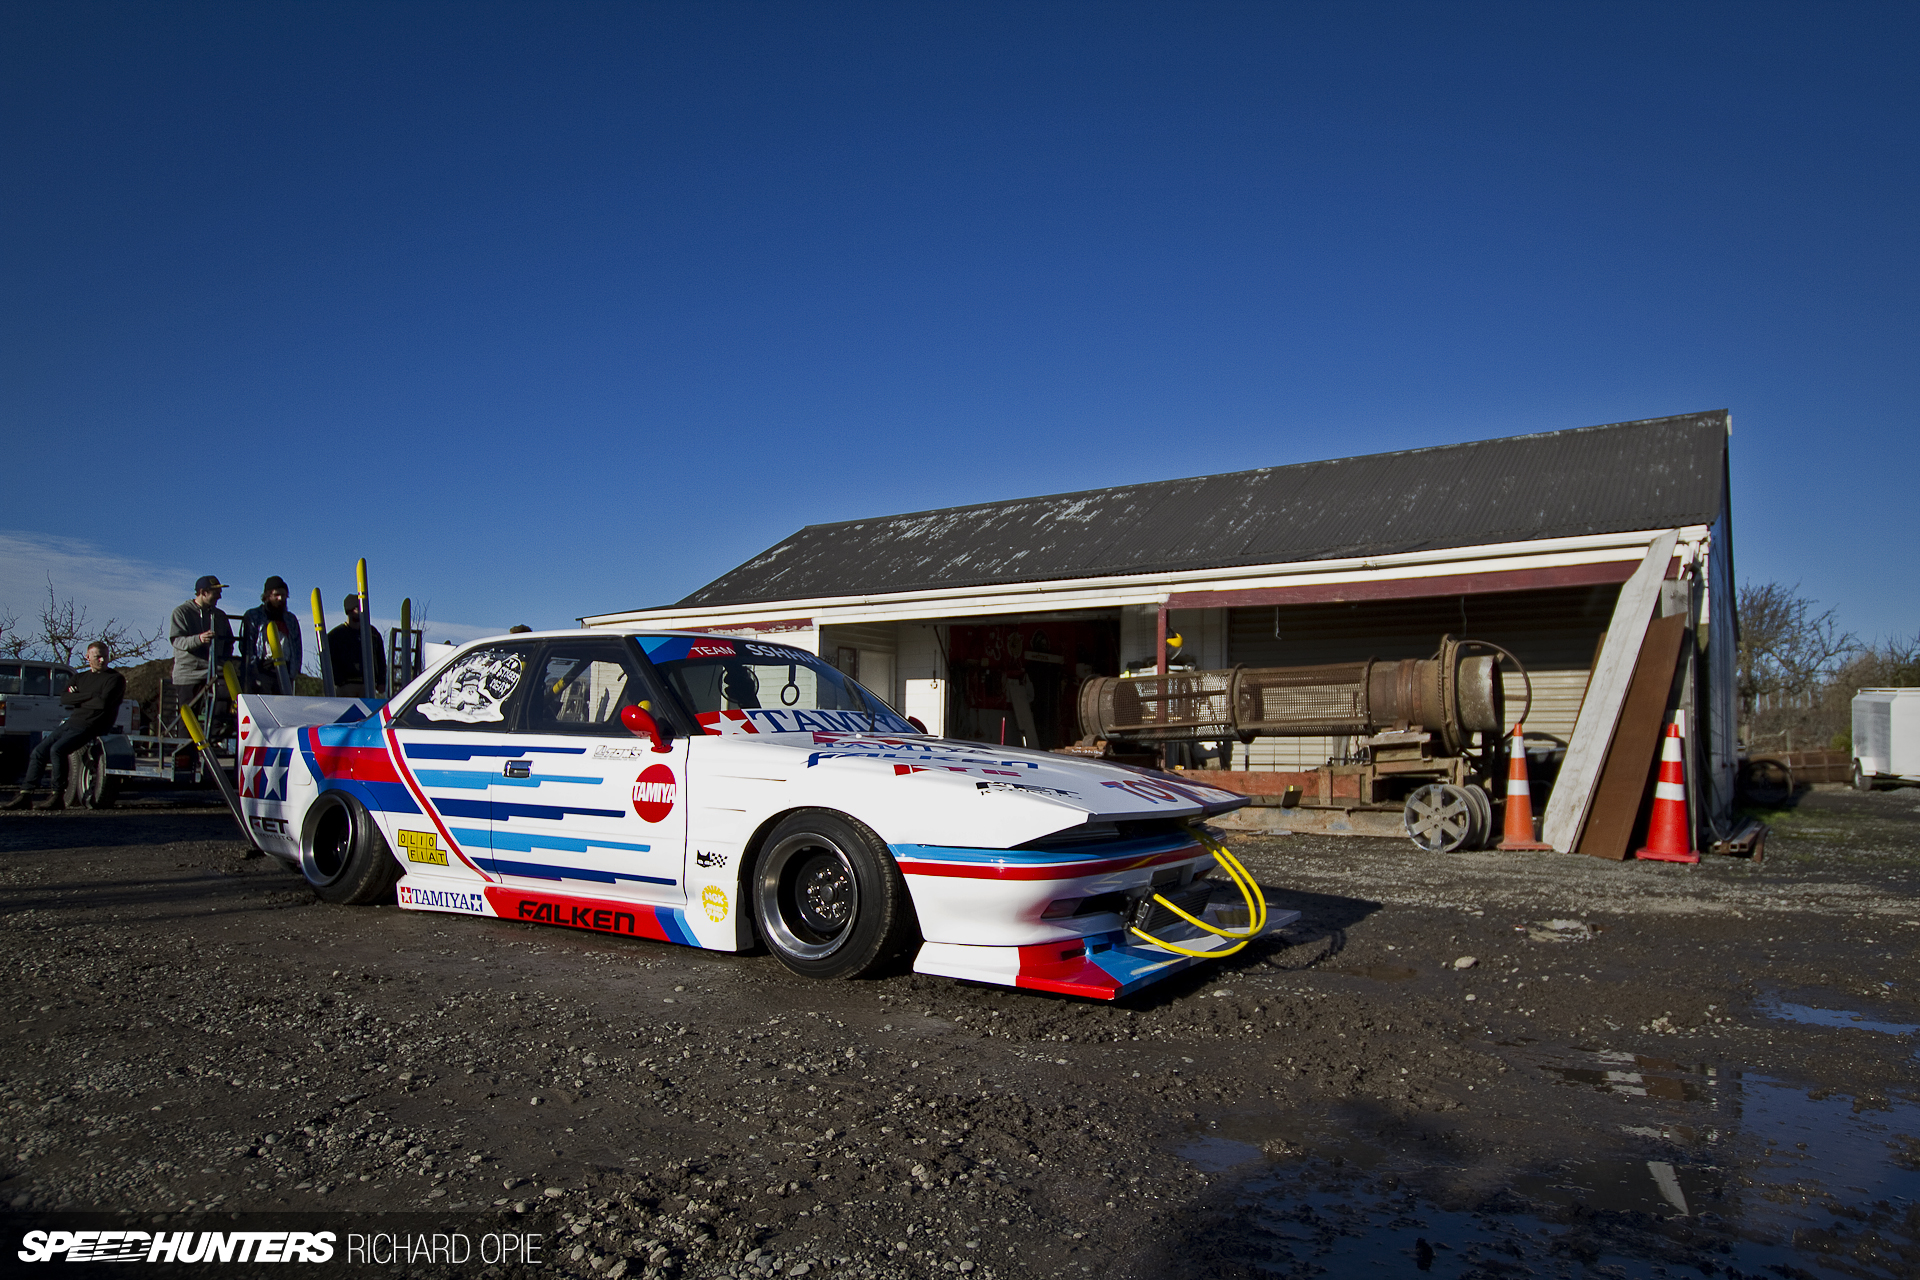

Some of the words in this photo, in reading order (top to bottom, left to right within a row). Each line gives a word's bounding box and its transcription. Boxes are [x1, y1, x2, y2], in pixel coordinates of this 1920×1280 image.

[691, 645, 736, 656] TEAM
[745, 643, 820, 666] SSHHH
[751, 709, 916, 733] TAMIYA
[633, 782, 676, 804] TAMIYA
[400, 833, 434, 847] OLIO
[410, 850, 444, 863] FIAT
[411, 888, 470, 910] TAMIYA
[704, 892, 725, 905] NGK
[517, 900, 635, 933] FALKEN
